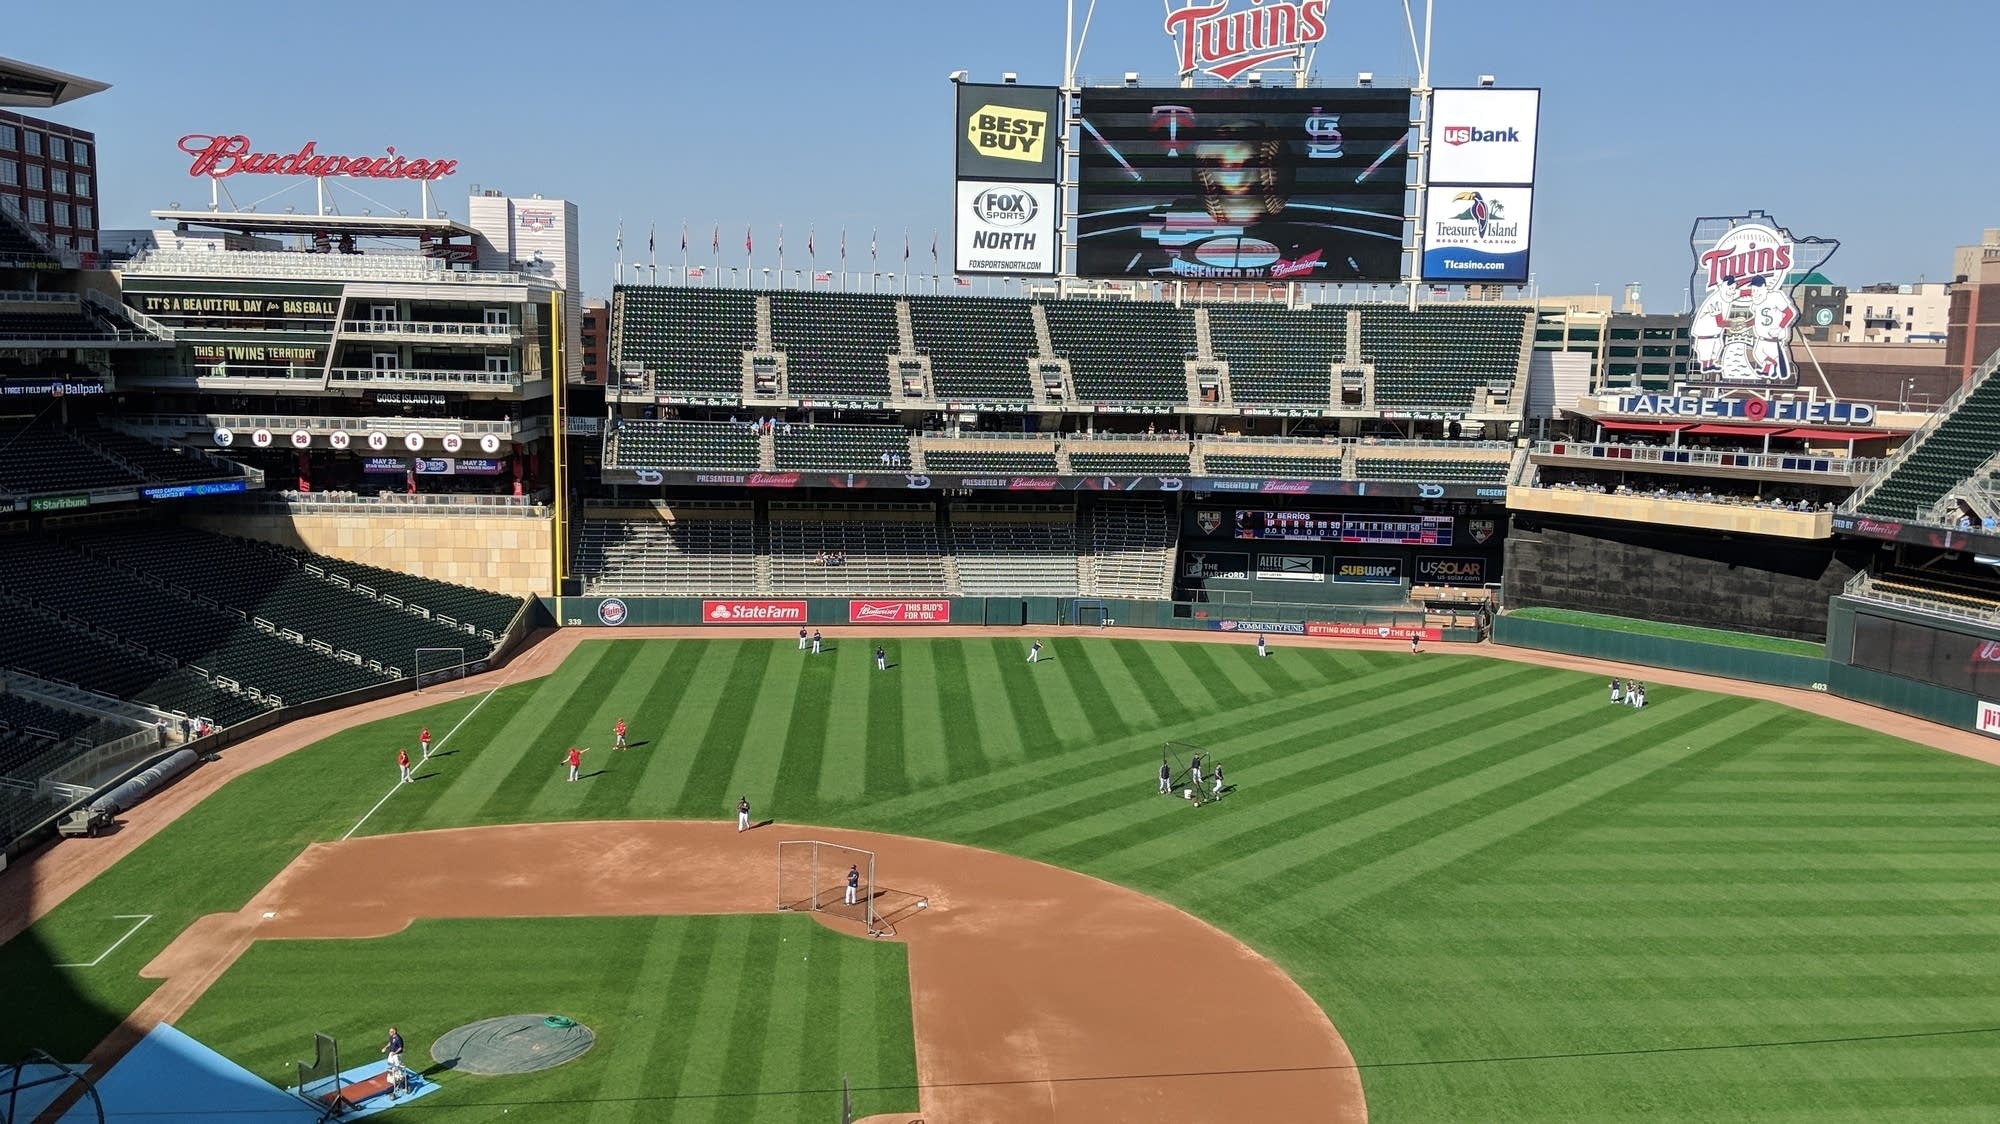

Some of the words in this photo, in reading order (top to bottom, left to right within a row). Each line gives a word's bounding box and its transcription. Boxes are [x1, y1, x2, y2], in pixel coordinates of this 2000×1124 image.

[1165, 0, 1327, 76] Twins
[978, 114, 1044, 137] BEST
[979, 131, 1037, 153] BUY
[178, 134, 458, 180] Budweiser
[987, 194, 1024, 212] FOX
[986, 212, 1025, 220] SPORTS
[1436, 221, 1477, 237] Treasure
[1487, 222, 1517, 237] Island
[973, 230, 1036, 250] NORTH
[969, 260, 1041, 270] FOXSPORTSNORTH.COM
[1702, 243, 1791, 287] Twins
[147, 298, 170, 311] IT'S
[173, 298, 181, 310] A
[183, 298, 241, 312] BEAUTIFUL
[243, 300, 262, 312] DAY
[283, 301, 335, 315] BASEBALL
[193, 346, 213, 357] THIS
[216, 346, 225, 357] IS
[227, 347, 264, 360] TWINS
[268, 348, 316, 359] TERRITORY
[4, 386, 24, 394] TARGET
[25, 386, 41, 394] FIELD
[65, 384, 104, 396] Ballpark
[377, 393, 400, 403] GOOSE
[402, 394, 429, 404] ISLAND
[430, 394, 446, 404] PUB
[1618, 395, 1741, 417] TARGET
[1774, 401, 1873, 424] FIELD
[218, 434, 228, 442] 42
[296, 435, 307, 443] 28
[334, 436, 346, 444] 34
[373, 437, 382, 445] 14
[411, 437, 417, 446] 6
[447, 439, 458, 447] 29
[487, 439, 493, 448] 3
[697, 475, 732, 483] PRESENTED
[734, 475, 744, 483] BY
[751, 474, 797, 485] Budweiser
[961, 478, 997, 486] PRESENTED
[999, 479, 1006, 487] BY
[1012, 478, 1056, 488] Budweiser
[1213, 481, 1248, 489] PRESENTED
[1250, 482, 1258, 490] BY
[1263, 481, 1310, 491] Budweiser
[1477, 488, 1507, 497] PRESENT
[1199, 512, 1220, 520] MLB
[1845, 520, 1854, 529] BY
[1857, 520, 1899, 537] Budweiser
[1260, 556, 1282, 567] ALTEC
[1339, 565, 1393, 577] SUBWAY
[862, 607, 897, 615] Budweiser
[904, 603, 921, 611] THIS
[922, 603, 943, 611] BUD'S
[904, 611, 918, 619] FOR
[1238, 622, 1283, 631] COMMUNITY
[1284, 623, 1304, 632] FUND
[1340, 627, 1360, 635] MORE
[1812, 682, 1828, 691] 403
